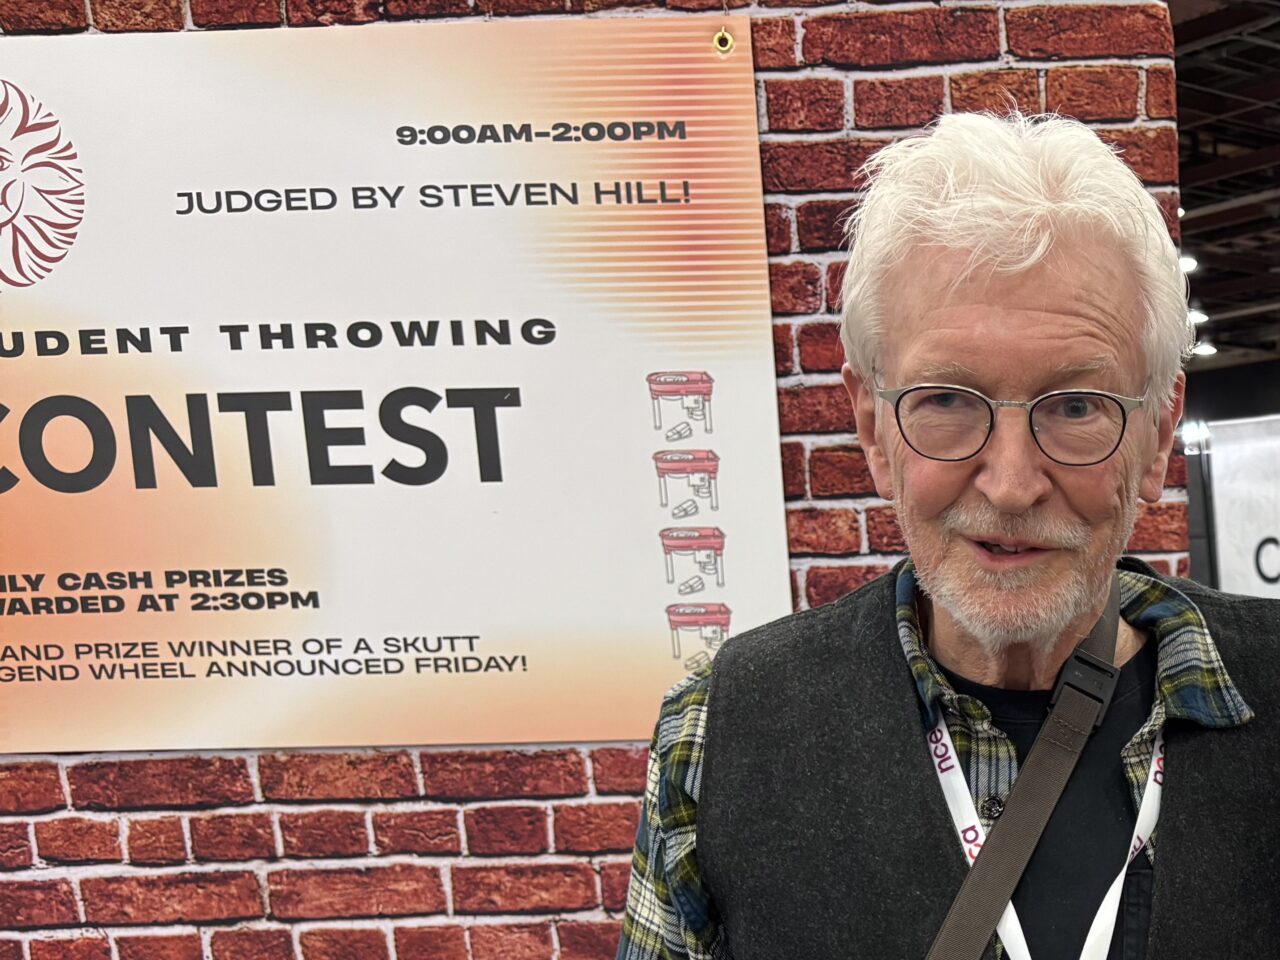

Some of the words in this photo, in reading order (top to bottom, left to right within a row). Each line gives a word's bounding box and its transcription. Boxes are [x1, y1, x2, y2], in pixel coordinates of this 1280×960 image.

[176, 188, 337, 214] JUDGED
[352, 186, 404, 209] BY
[420, 183, 578, 207] STEVEN
[594, 181, 691, 205] HILL!
[220, 319, 555, 350] THROWING
[58, 571, 153, 591] CASH
[165, 569, 288, 588] PRIZES
[0, 596, 125, 615] ARDED
[137, 594, 179, 612] AT
[190, 592, 319, 610] 2:30PM
[75, 642, 159, 659] PRIZE
[168, 640, 291, 657] WINNER
[302, 639, 341, 654] OF
[354, 638, 373, 653] A
[384, 636, 480, 653] SKUTT
[88, 662, 195, 679] WHEEL
[206, 659, 404, 677] ANNOUNCED
[415, 656, 527, 673] FRIDAY!
